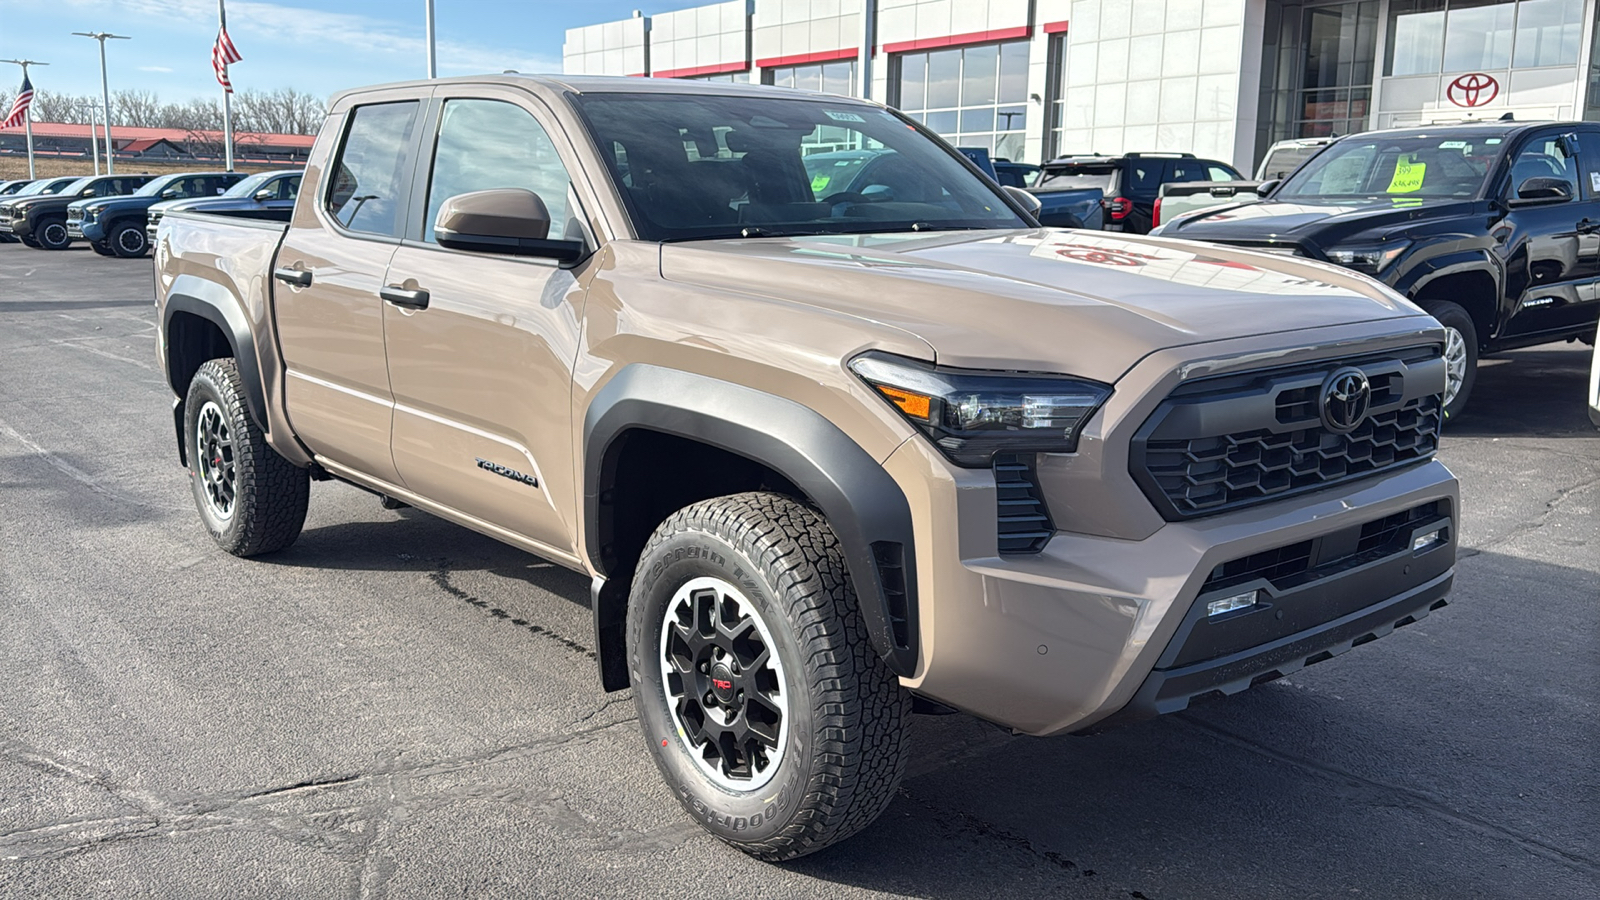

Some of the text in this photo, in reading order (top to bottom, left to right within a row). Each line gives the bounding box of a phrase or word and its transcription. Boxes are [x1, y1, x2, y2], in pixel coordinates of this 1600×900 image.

[1522, 298, 1553, 307] TACOMA
[475, 456, 539, 489] TACOMA
[712, 678, 732, 690] TRD
